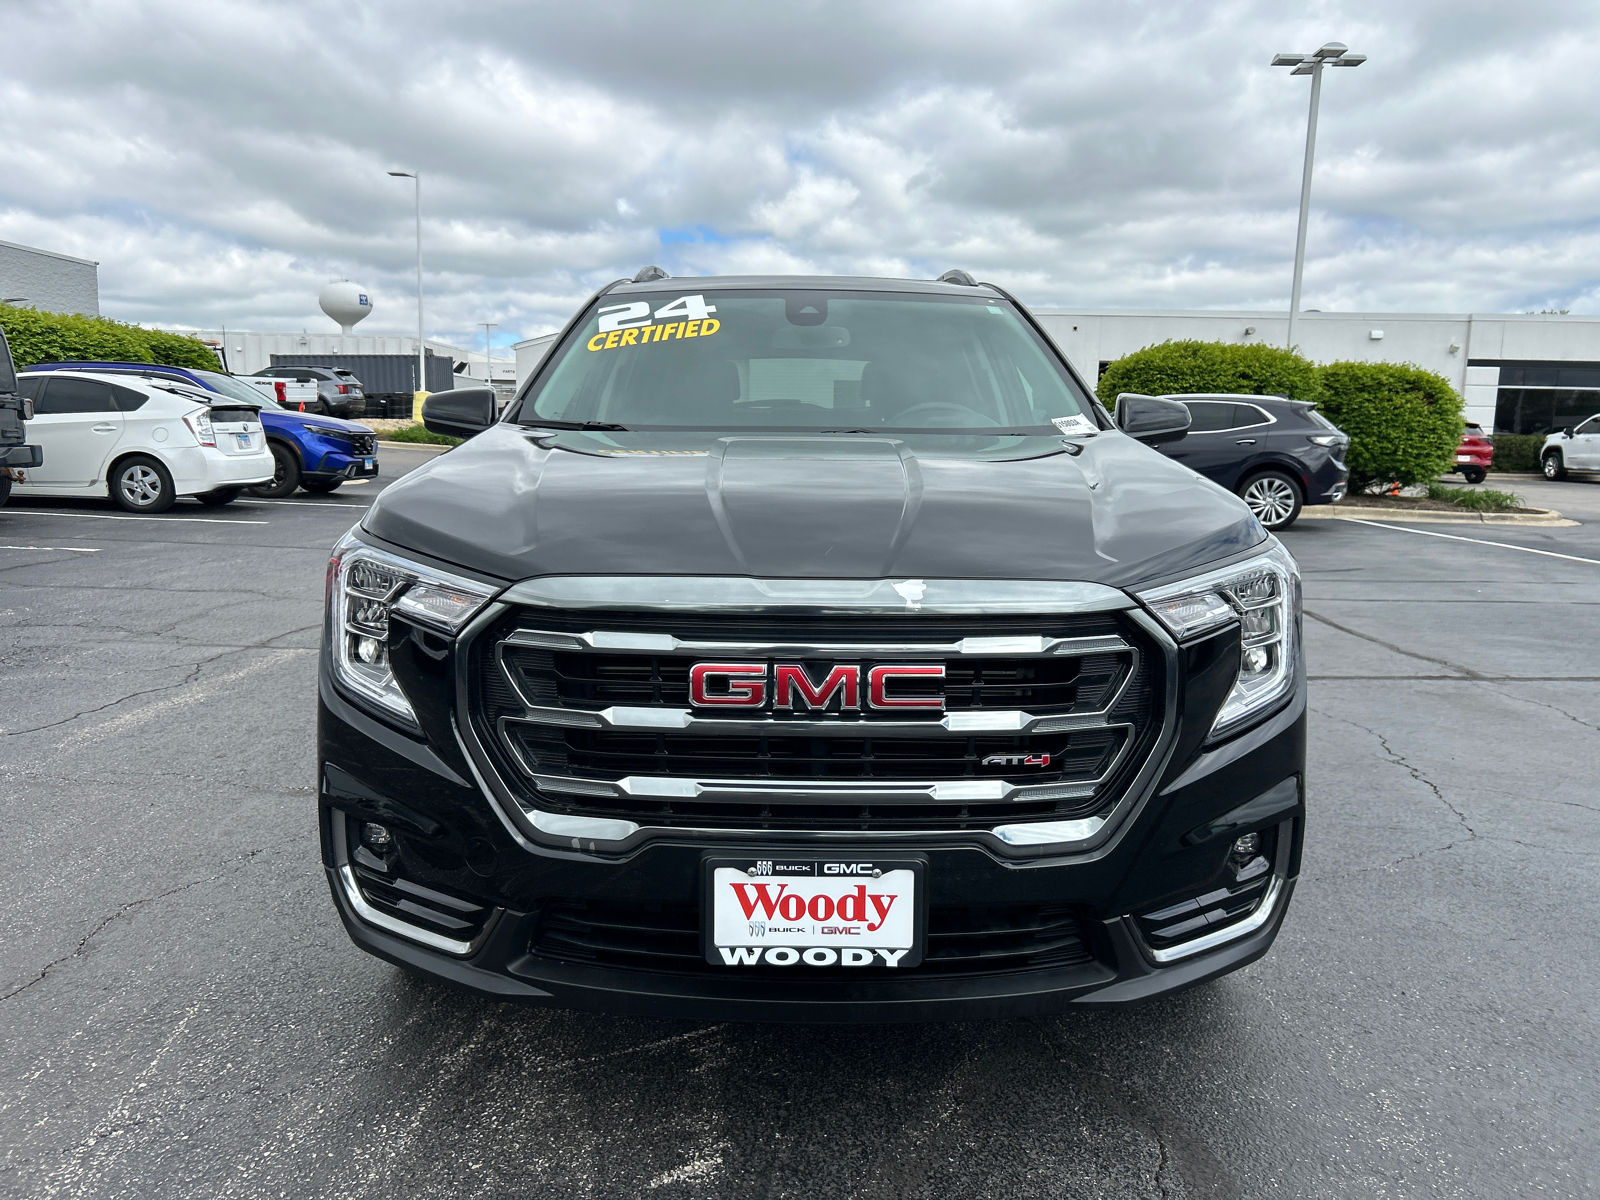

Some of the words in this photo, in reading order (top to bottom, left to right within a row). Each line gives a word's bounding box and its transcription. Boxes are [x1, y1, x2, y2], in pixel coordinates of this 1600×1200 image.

[598, 294, 717, 333] 24
[587, 318, 721, 352] CERTIFIED
[688, 662, 947, 710] GMC
[981, 754, 1050, 768] AT4
[776, 864, 811, 872] BUICK
[824, 863, 873, 874] GMC
[729, 882, 898, 932] Woody
[820, 926, 861, 935] GMC
[718, 947, 909, 967] WOODY
